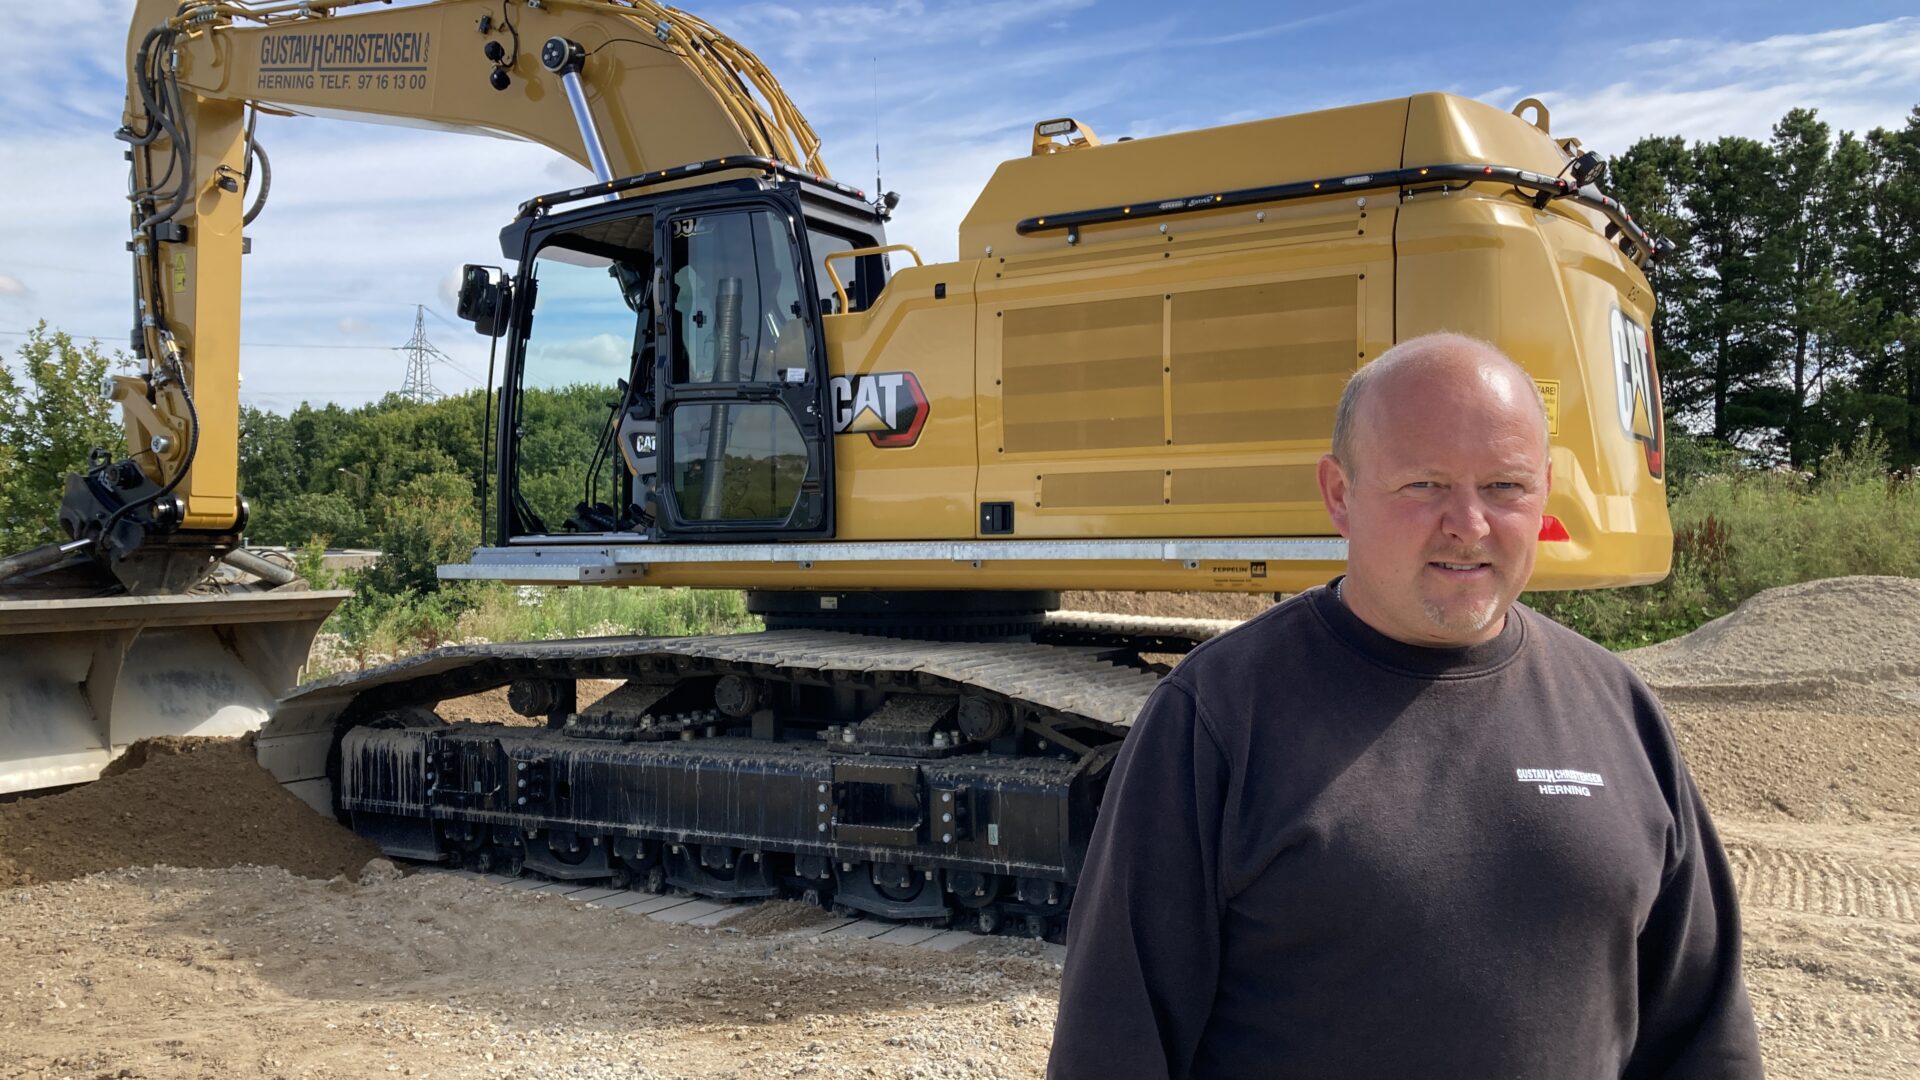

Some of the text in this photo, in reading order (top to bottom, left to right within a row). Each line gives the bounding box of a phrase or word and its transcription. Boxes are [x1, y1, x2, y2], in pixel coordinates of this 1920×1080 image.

[260, 35, 312, 65] GUSTAV
[324, 32, 422, 64] CHRISTENSEN
[257, 74, 427, 89] HERNING TELF. 97 16 13 00
[1611, 309, 1655, 440] CAT
[830, 373, 904, 432] CAT
[636, 435, 657, 453] CAT
[1516, 768, 1546, 779] GUSTAV
[1554, 769, 1603, 784] CHRISTENSEN
[1538, 784, 1592, 797] HERNING
